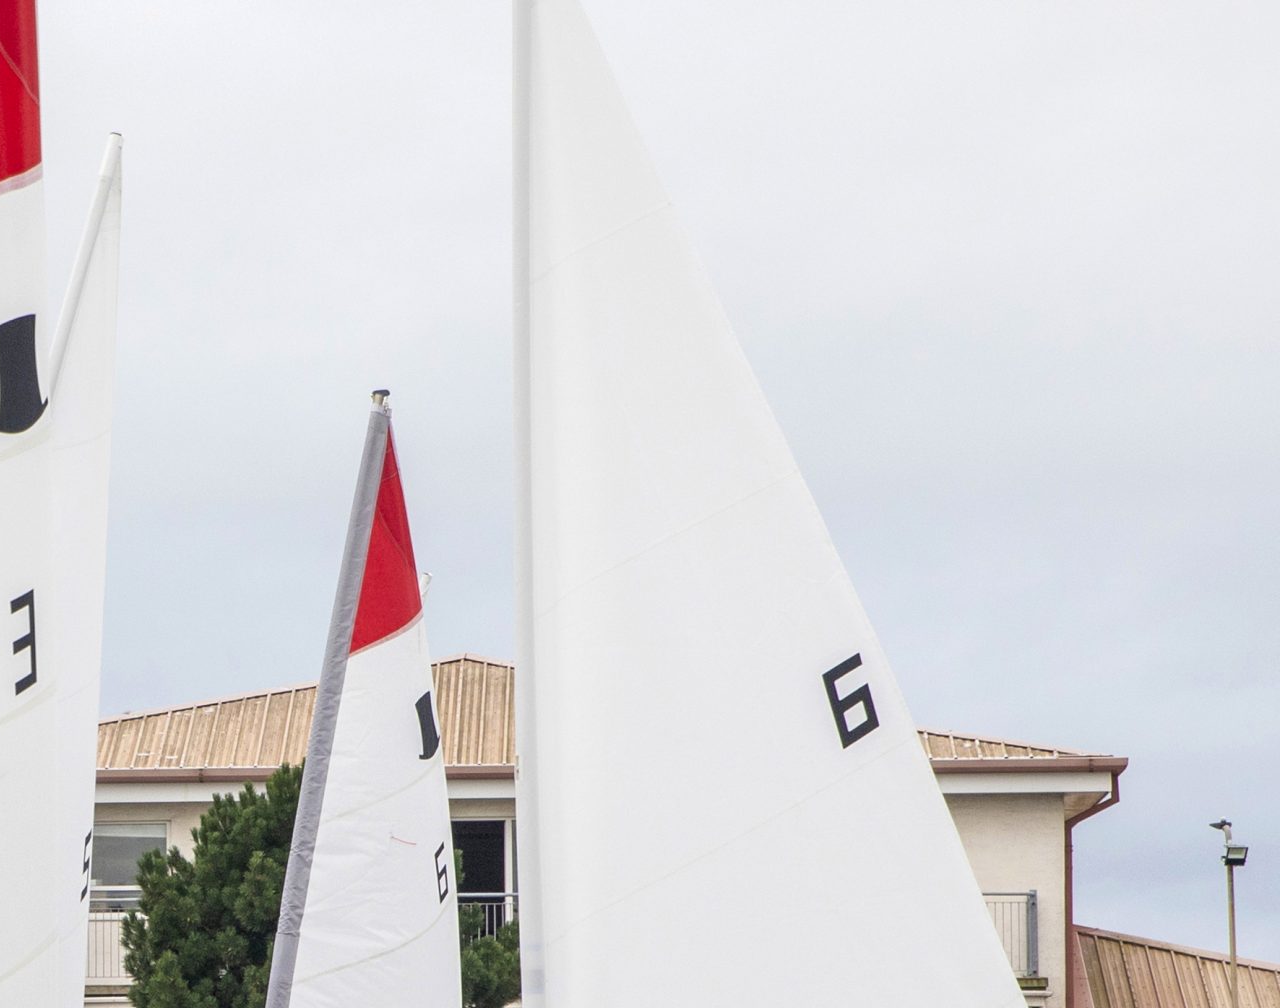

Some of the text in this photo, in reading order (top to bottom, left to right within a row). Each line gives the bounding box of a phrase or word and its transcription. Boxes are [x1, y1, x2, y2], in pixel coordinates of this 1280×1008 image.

[10, 589, 37, 696] 3
[821, 652, 880, 749] 6
[434, 842, 449, 904] 6
